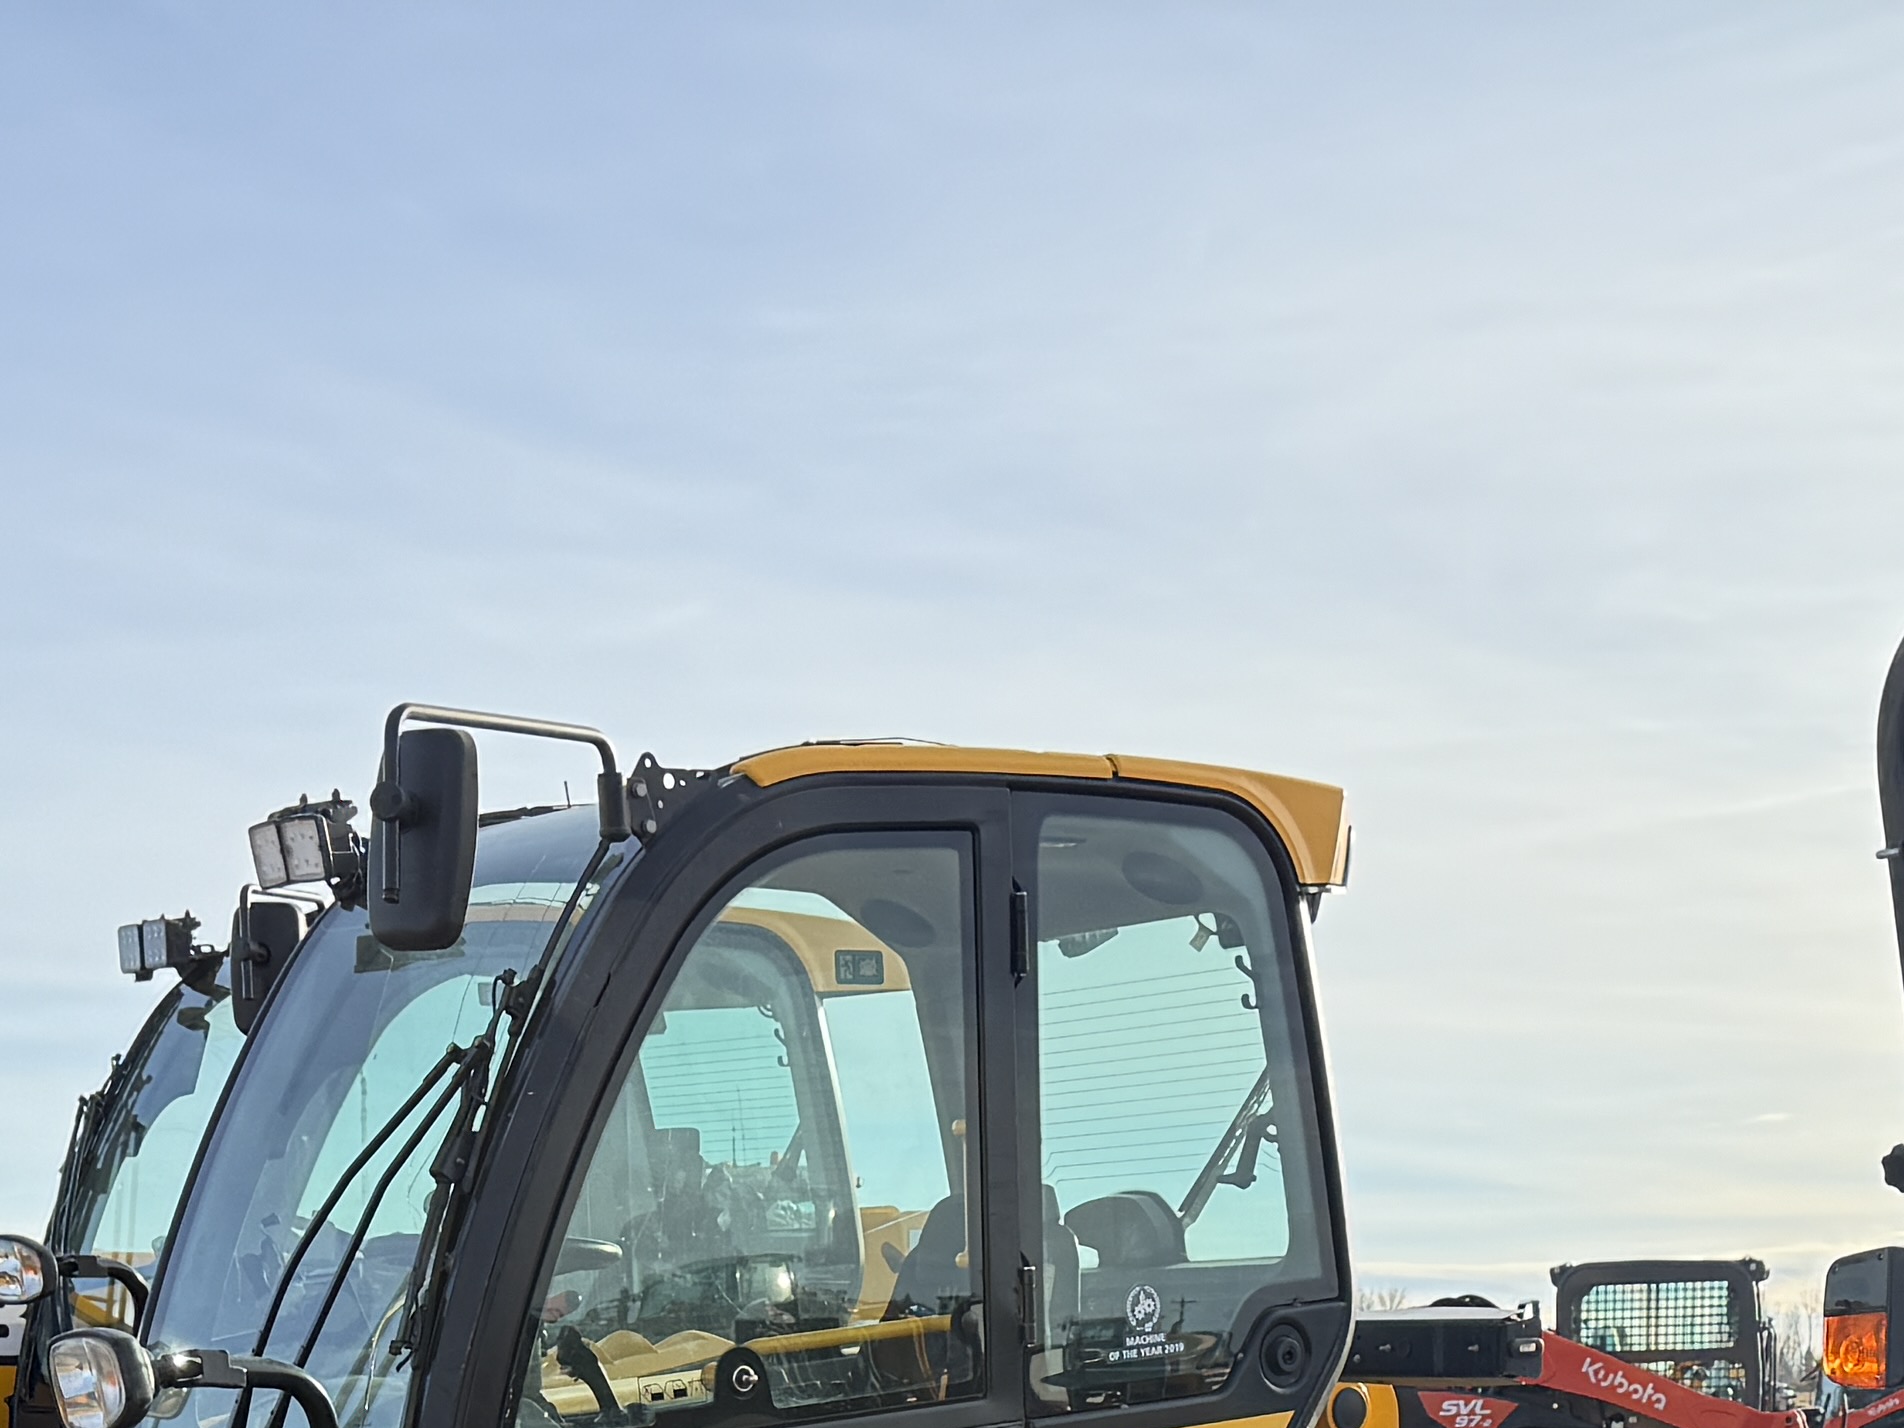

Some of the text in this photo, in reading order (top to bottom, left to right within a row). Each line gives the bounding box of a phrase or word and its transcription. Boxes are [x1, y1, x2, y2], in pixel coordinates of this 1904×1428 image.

[1126, 1333, 1166, 1346] MACHINE
[1109, 1343, 1184, 1361] OF THE YEAR 2019
[1581, 1357, 1667, 1411] Kubota
[1439, 1399, 1492, 1416] SVL
